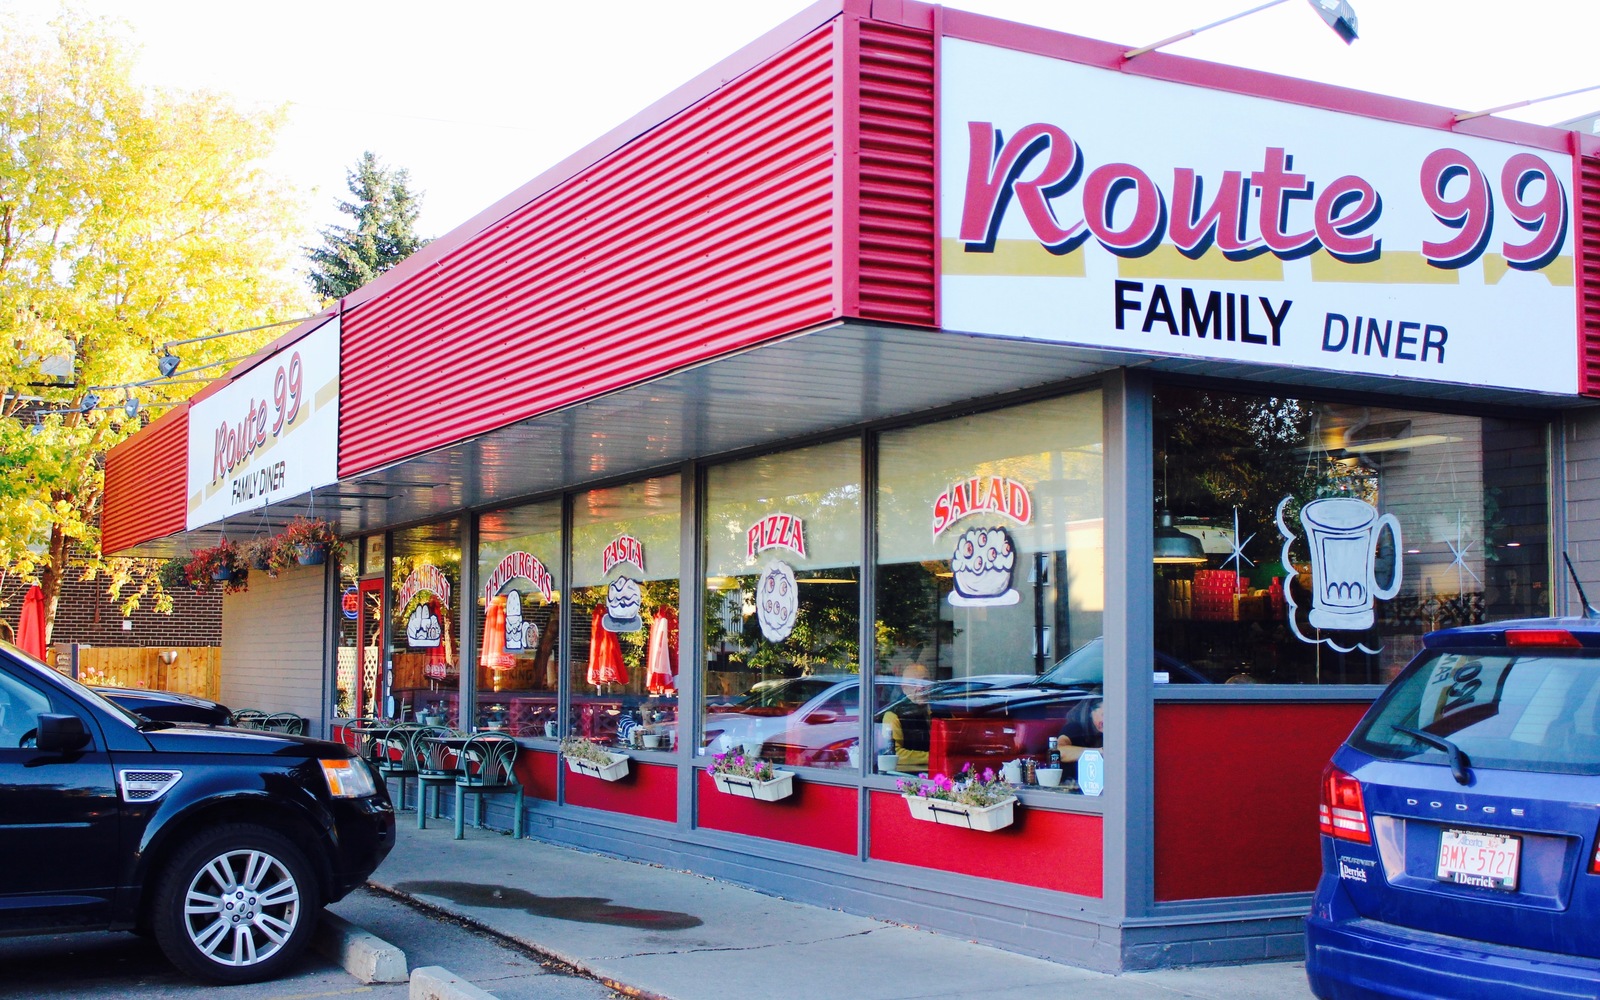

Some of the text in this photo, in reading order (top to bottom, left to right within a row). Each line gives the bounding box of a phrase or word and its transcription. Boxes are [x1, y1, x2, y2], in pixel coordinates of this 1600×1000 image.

[958, 121, 1568, 271] Route 99
[1114, 280, 1449, 364] FAMILY DINER
[212, 351, 303, 487] Route 99
[231, 460, 286, 506] FAMILY DINER
[932, 475, 1031, 540] SALAD
[602, 534, 644, 576] PASTA
[746, 511, 806, 560] PIZZA
[485, 551, 552, 614] HAMBURGERS
[1406, 798, 1525, 816] DODGE
[1458, 834, 1483, 848] Alberta
[1343, 864, 1367, 879] Derrick
[1460, 873, 1495, 888] Derrick
